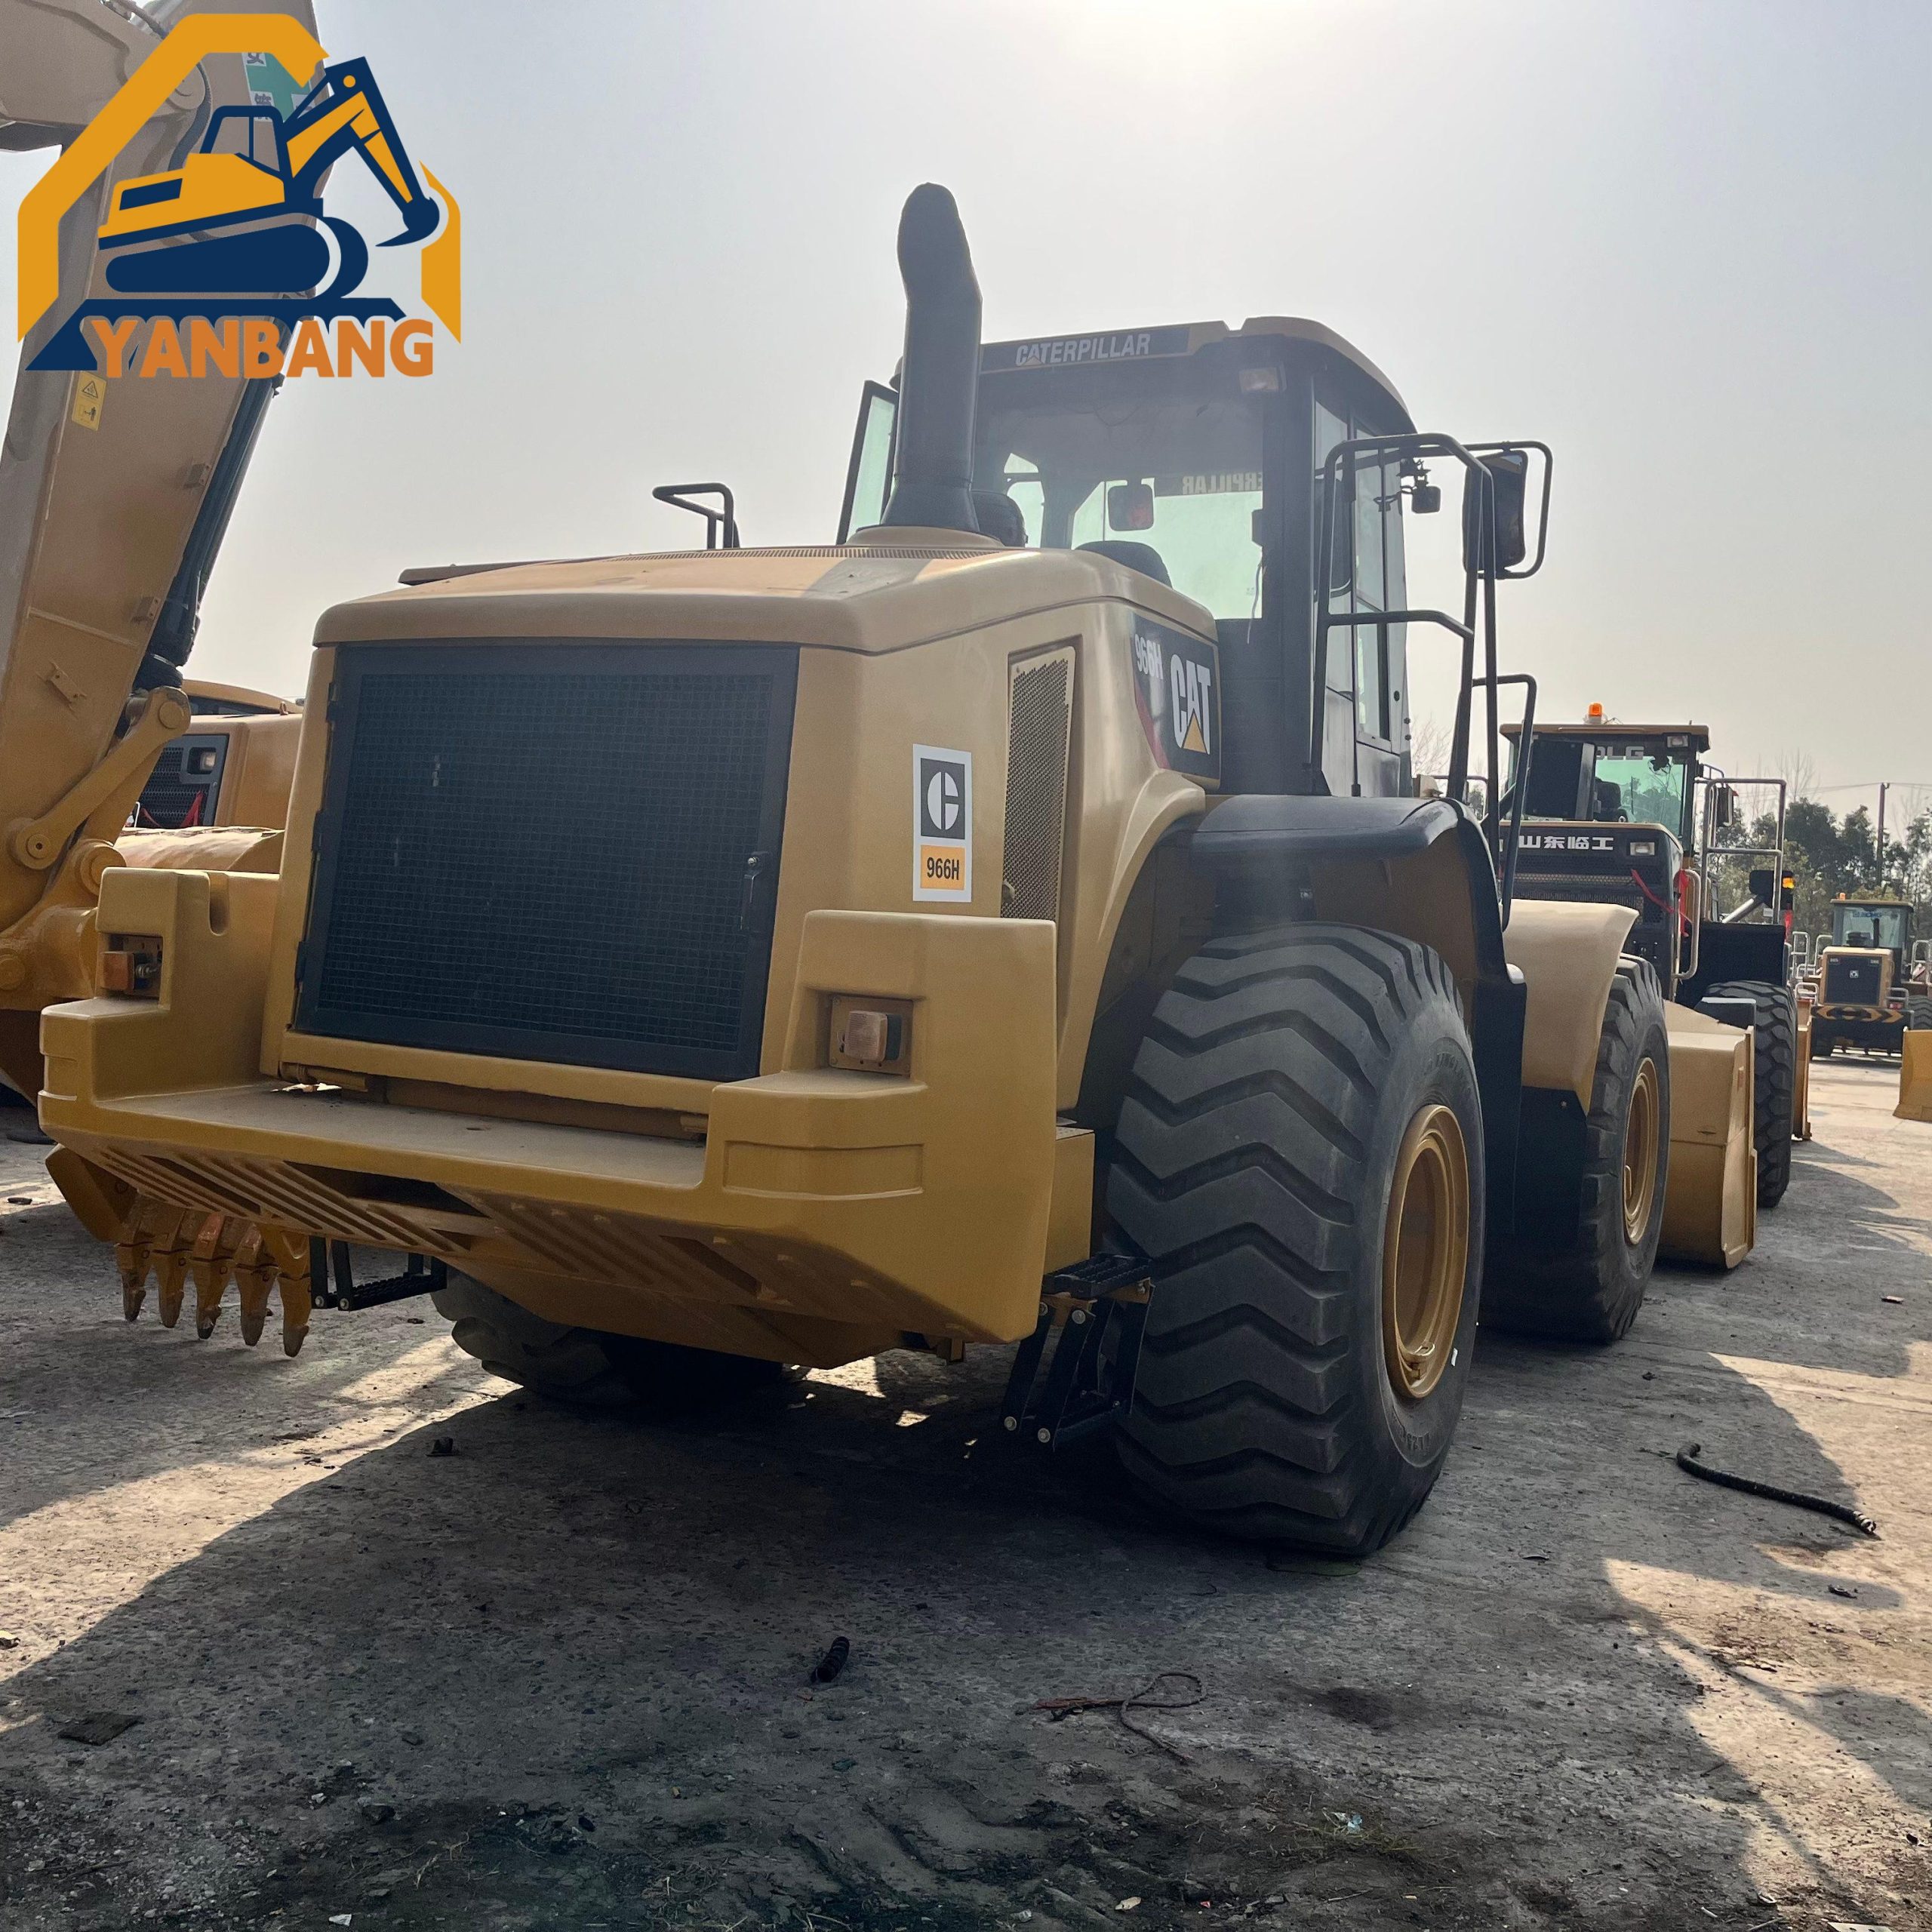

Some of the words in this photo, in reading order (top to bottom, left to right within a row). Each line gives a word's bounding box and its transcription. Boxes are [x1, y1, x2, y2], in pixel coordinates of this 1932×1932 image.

[1015, 334, 1151, 367] CATERPILLAR
[1134, 633, 1163, 679] 966H
[1171, 654, 1211, 755] CAT
[1518, 835, 1614, 851] 山东临工
[927, 857, 959, 880] 966H
